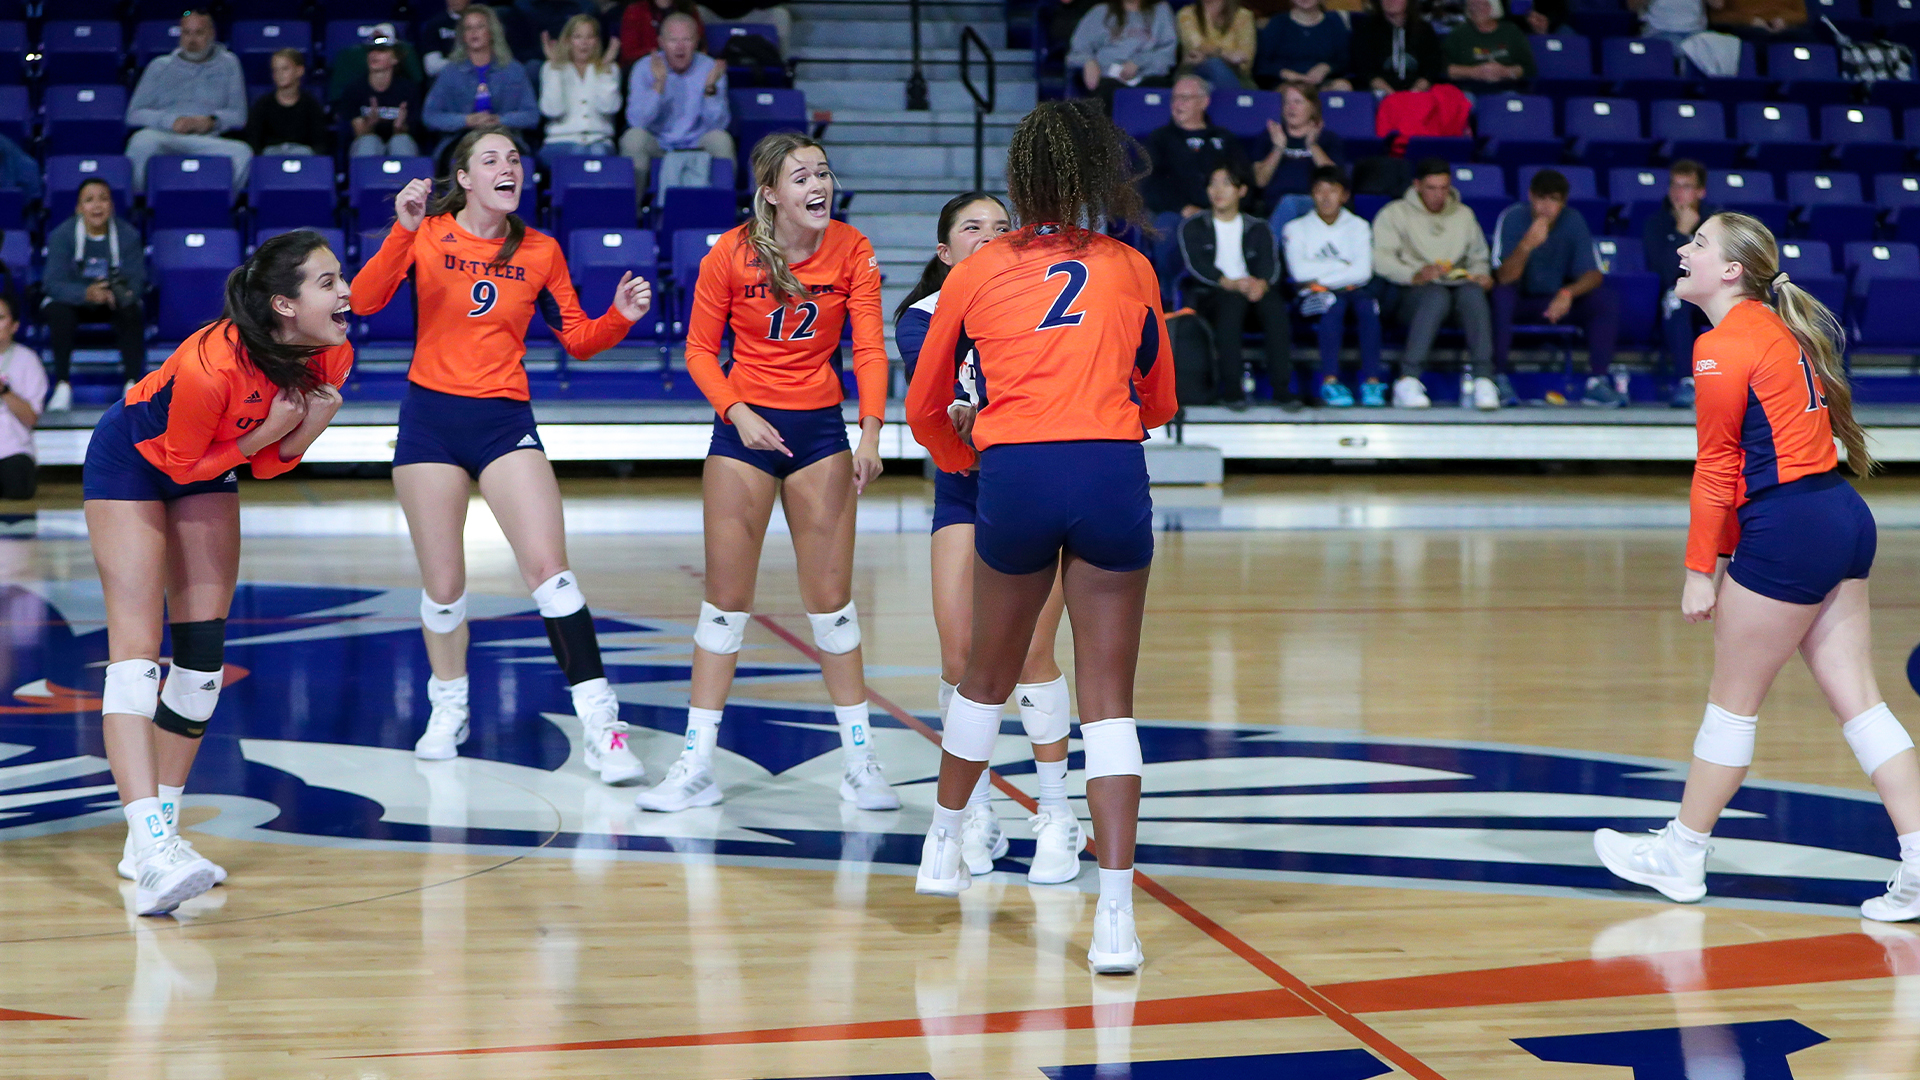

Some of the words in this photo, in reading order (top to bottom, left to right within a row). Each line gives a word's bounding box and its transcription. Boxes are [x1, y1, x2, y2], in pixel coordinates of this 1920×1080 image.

[467, 279, 499, 318] 9
[764, 301, 819, 341] 12
[1035, 259, 1089, 331] 2
[1798, 344, 1828, 412] 1
